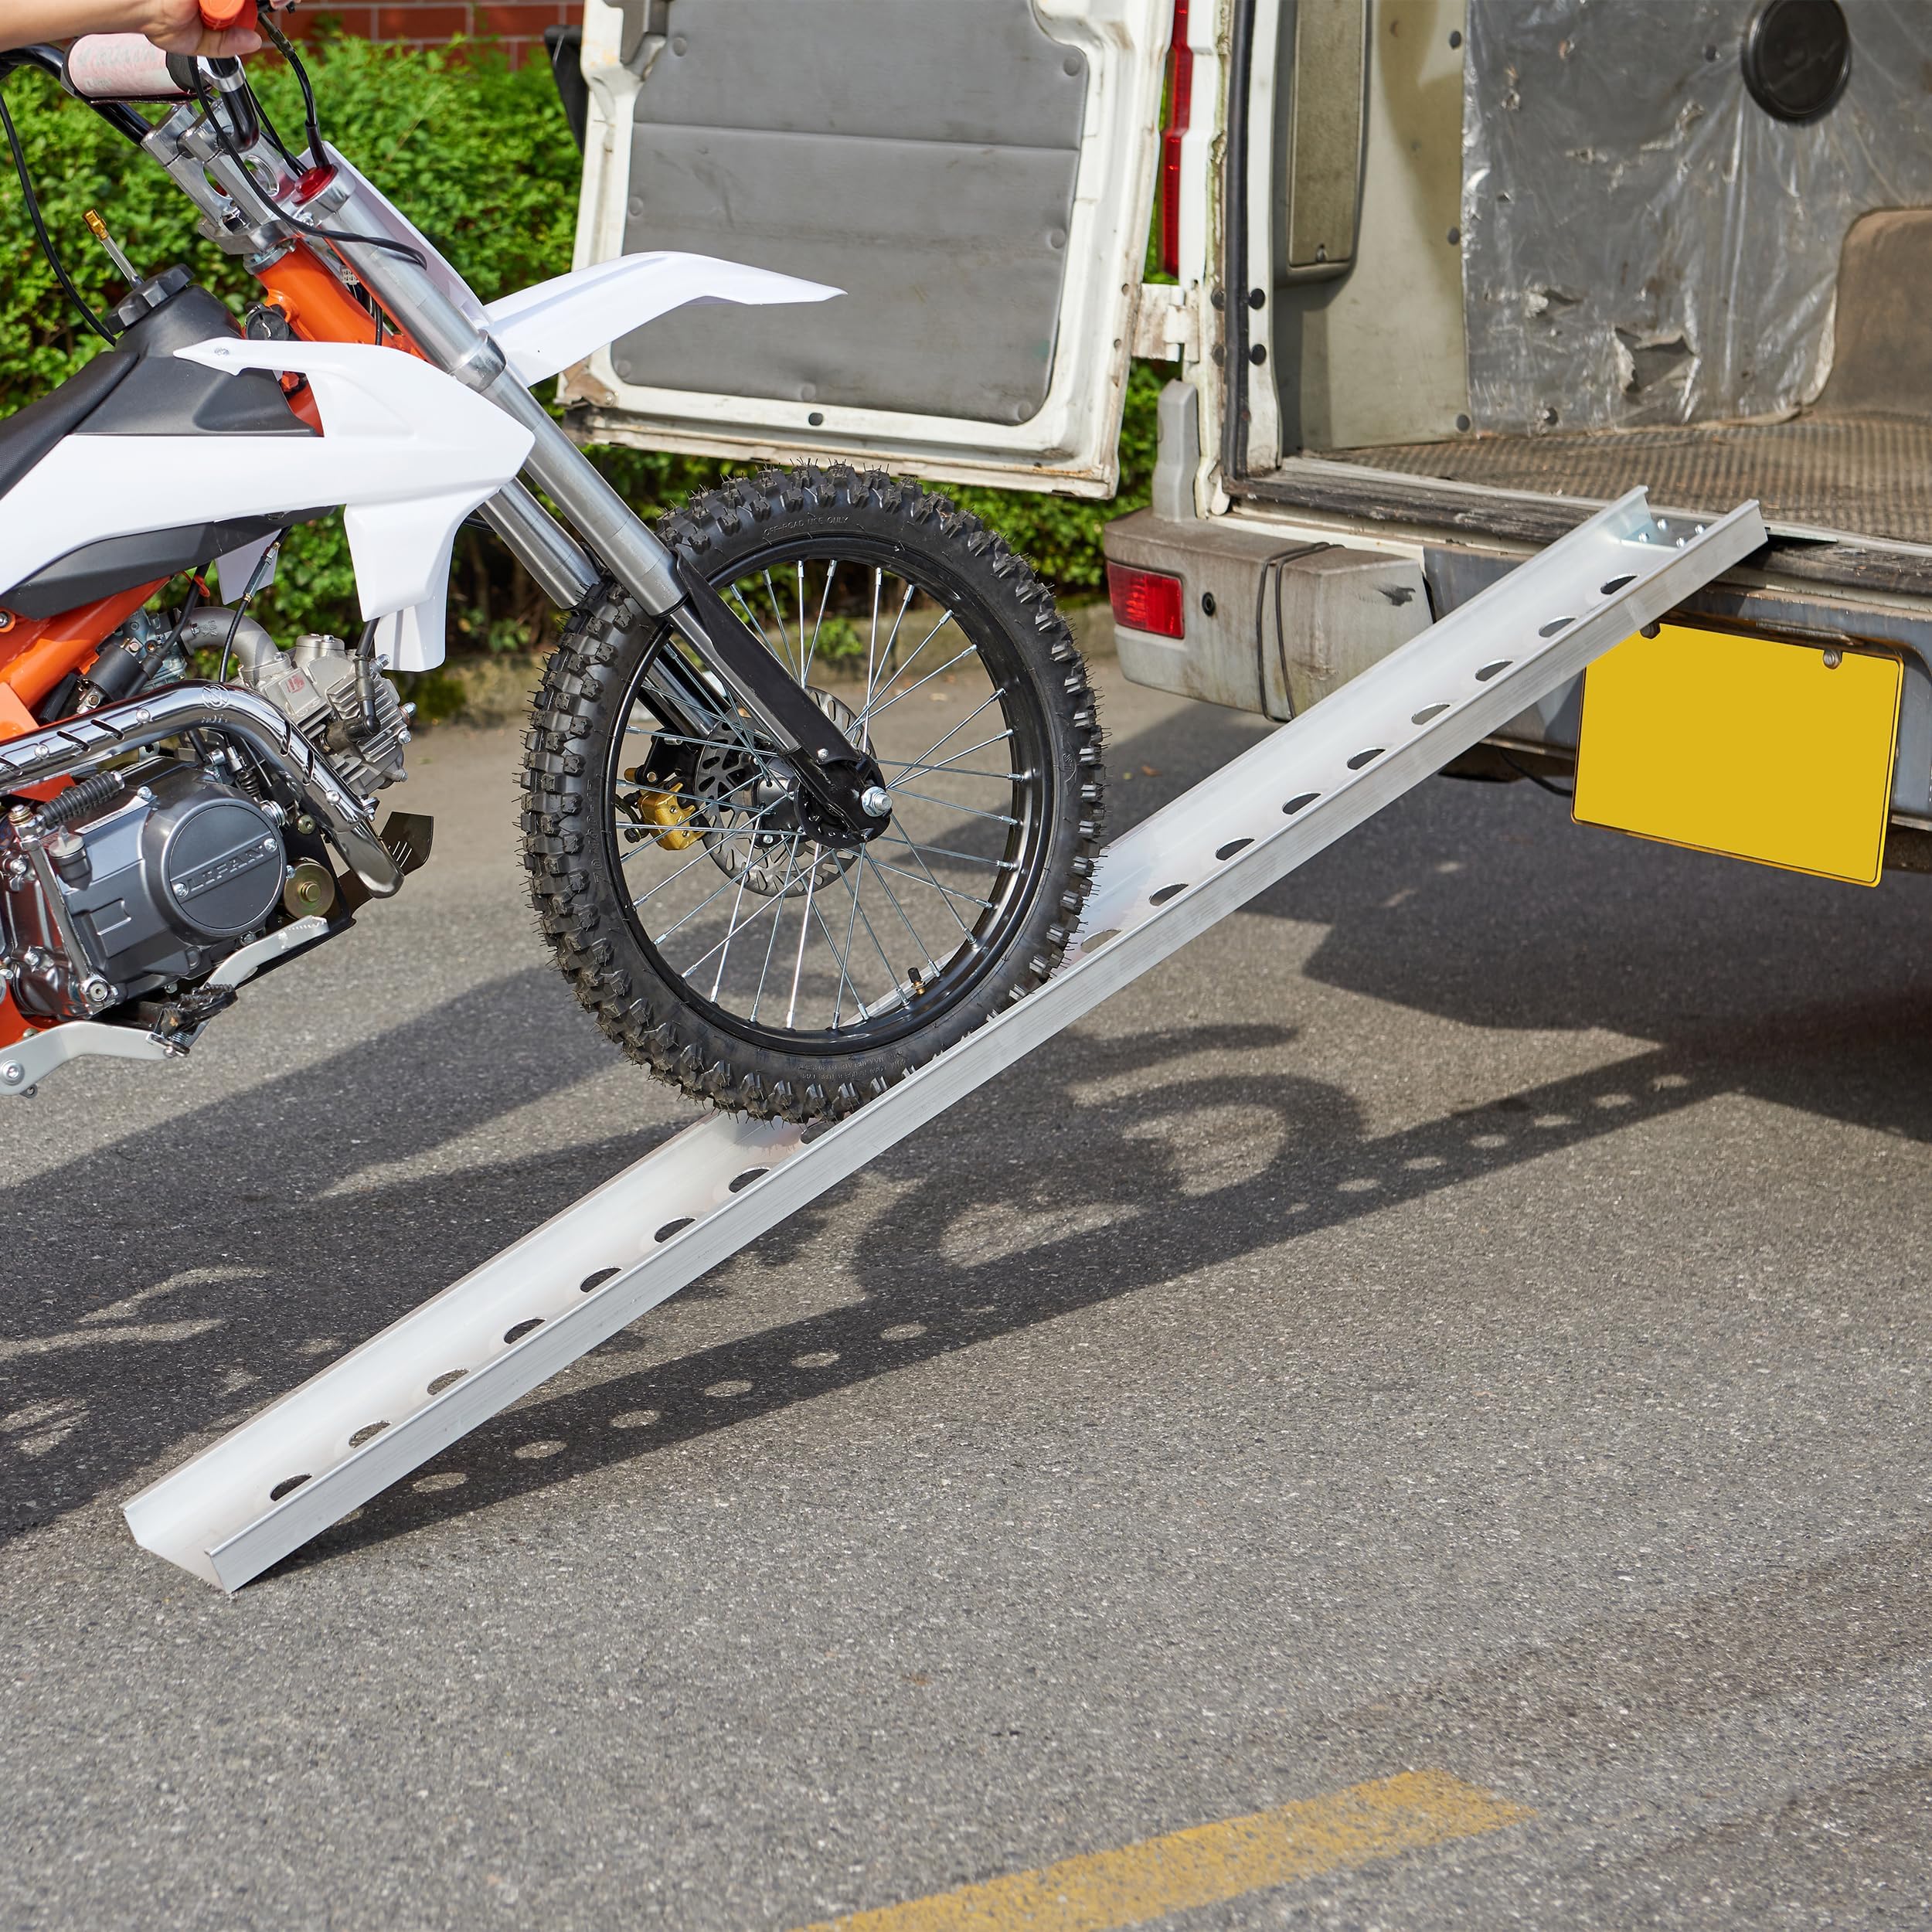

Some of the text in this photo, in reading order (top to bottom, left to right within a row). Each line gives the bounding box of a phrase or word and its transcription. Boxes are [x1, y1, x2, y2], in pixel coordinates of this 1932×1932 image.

[764, 516, 849, 536] OFF-ROAD USE ONLY
[187, 845, 264, 892] LIFAN
